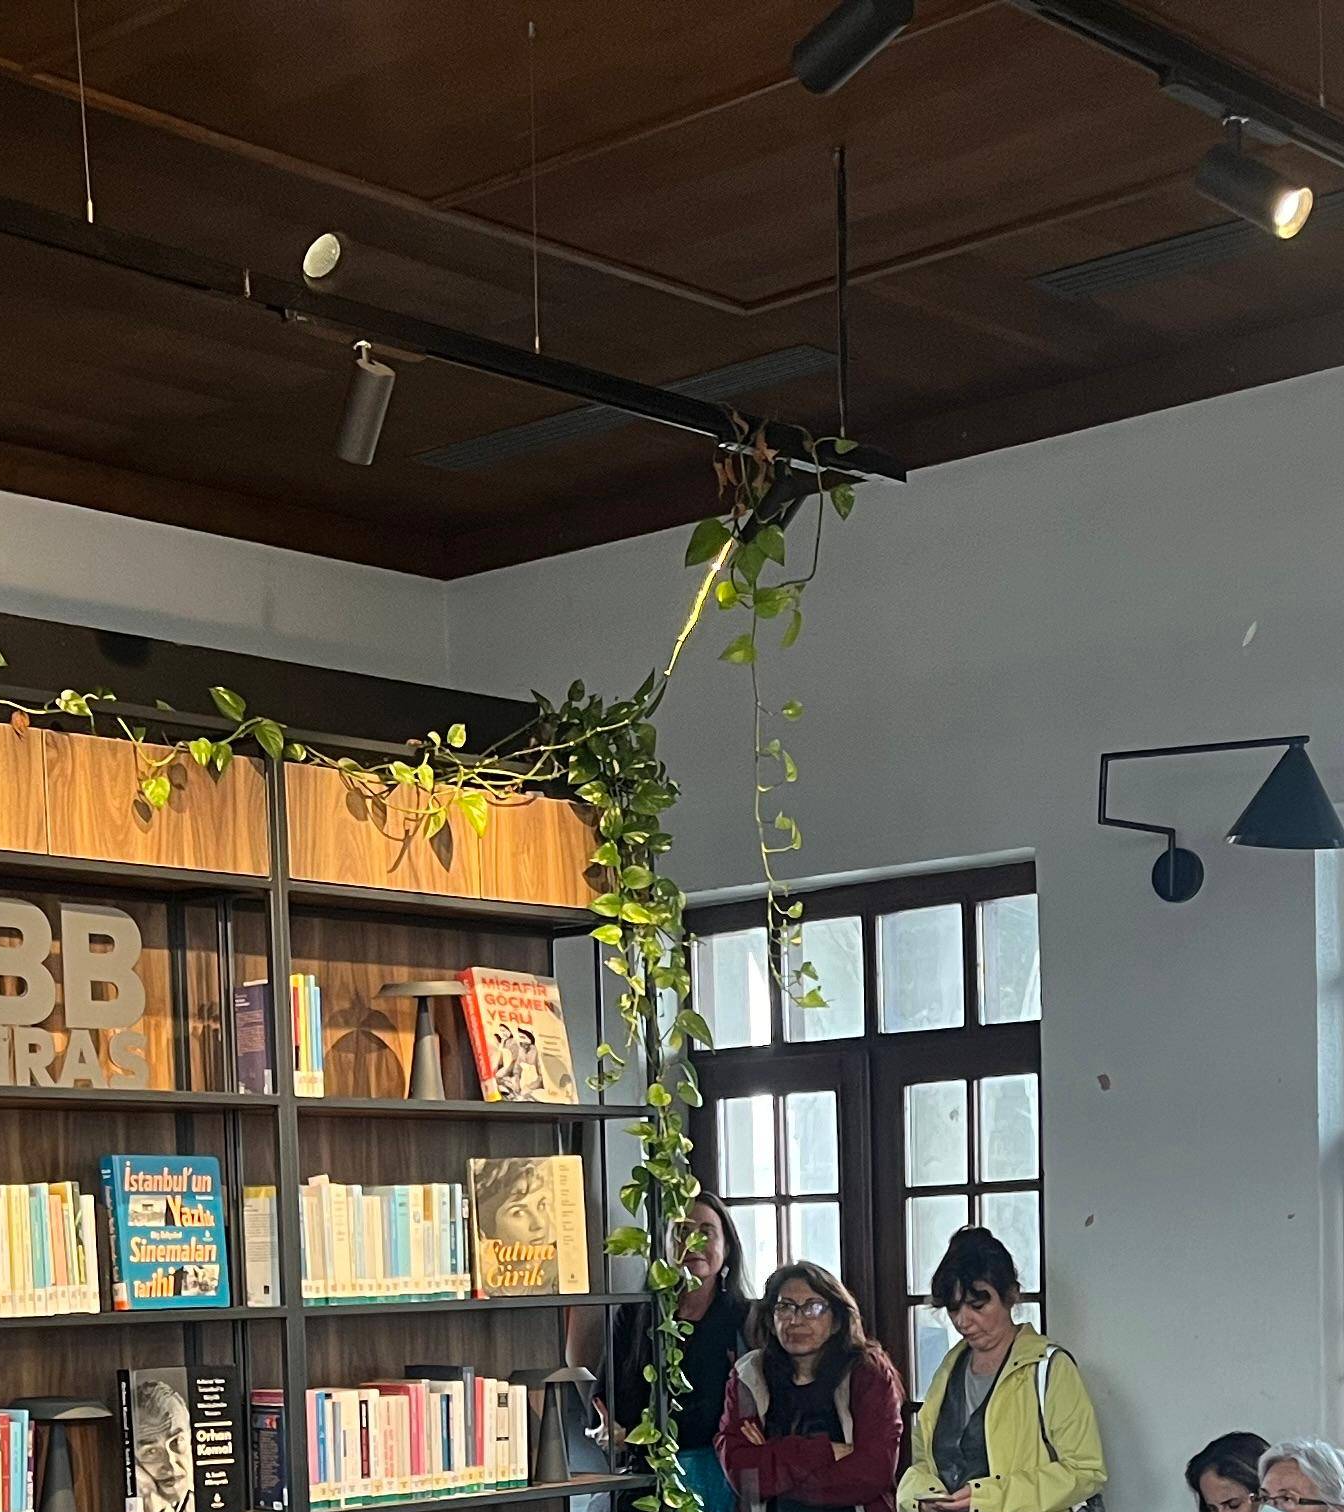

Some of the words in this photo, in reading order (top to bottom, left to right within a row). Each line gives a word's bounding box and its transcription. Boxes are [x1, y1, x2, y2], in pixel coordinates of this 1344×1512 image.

[124, 1161, 212, 1192] İstanbul'un
[196, 1429, 232, 1443] Orhan
[196, 1442, 233, 1456] Kemal
